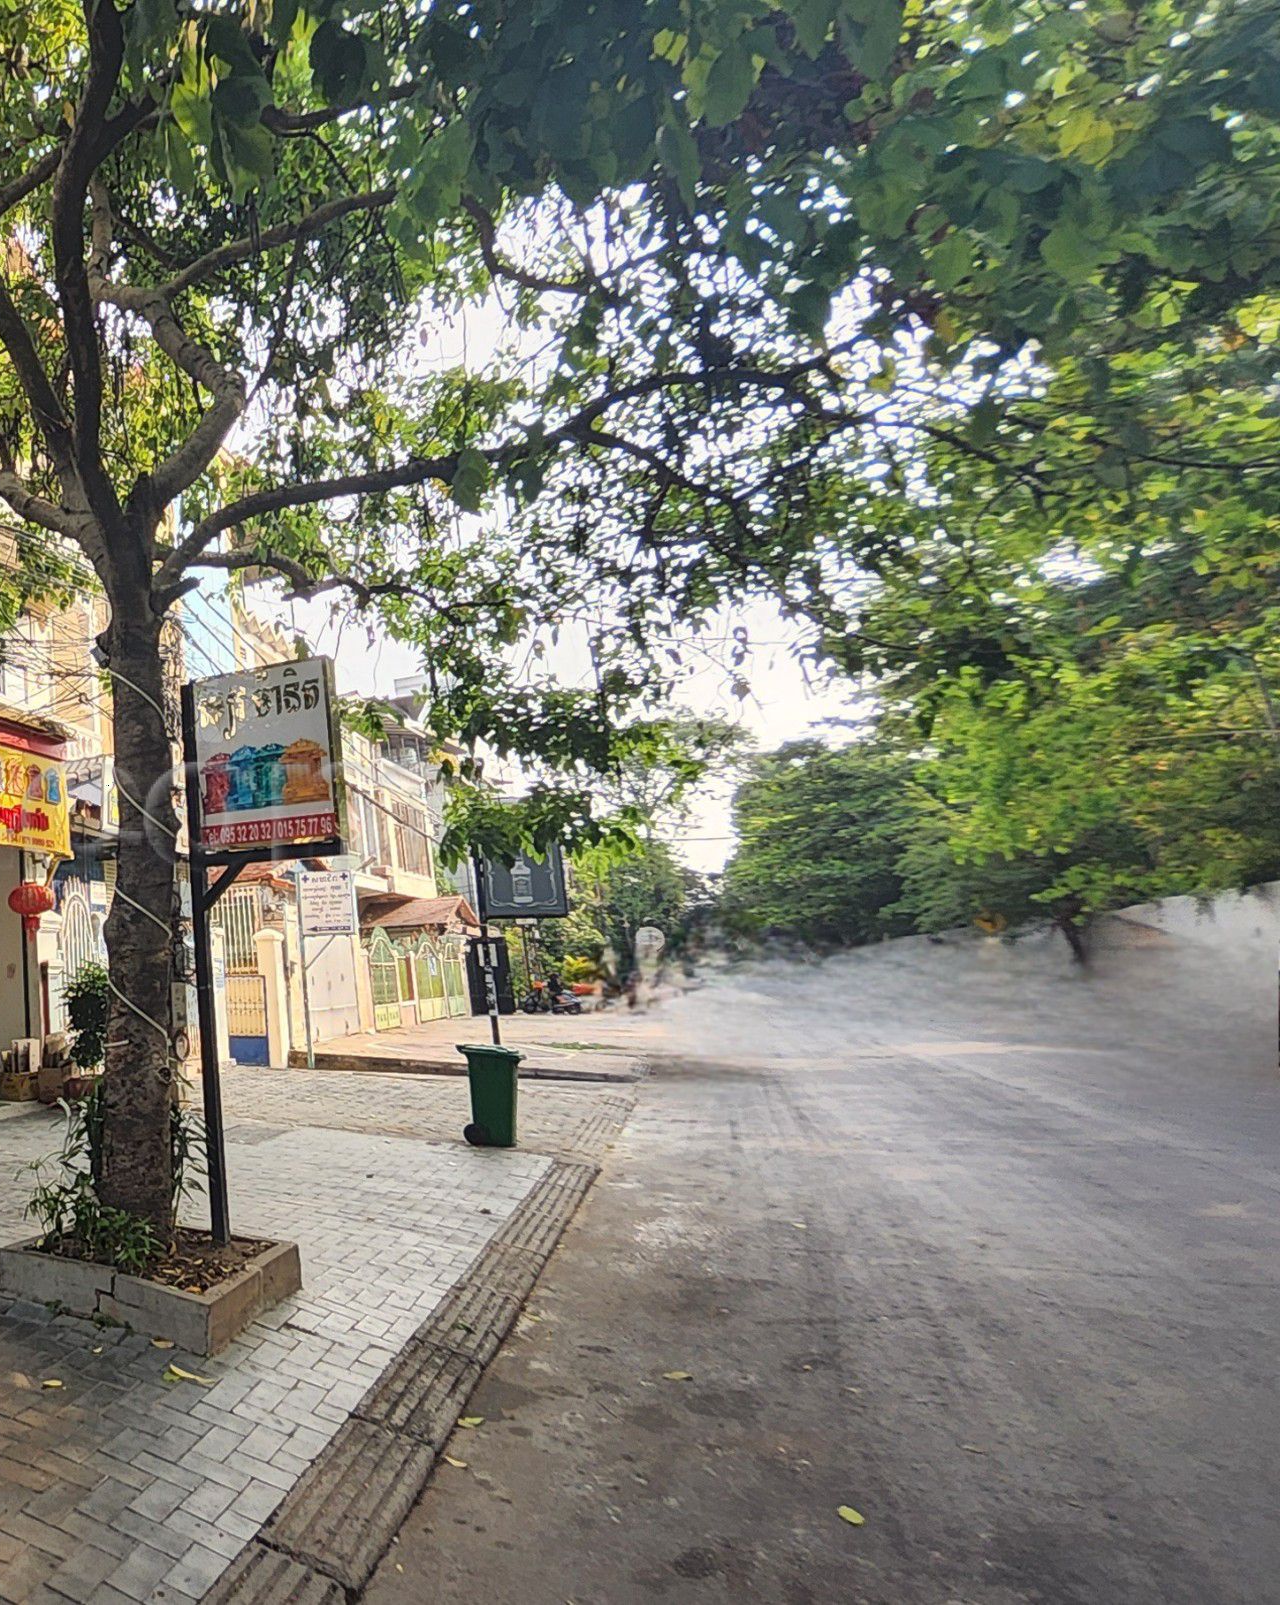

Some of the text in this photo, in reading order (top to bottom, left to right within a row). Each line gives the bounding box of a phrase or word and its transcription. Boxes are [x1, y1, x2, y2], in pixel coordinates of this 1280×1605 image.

[220, 826, 236, 844] 095
[236, 825, 248, 842] 32
[248, 823, 259, 841] 20
[260, 822, 272, 840] 32
[278, 819, 294, 838] 015
[295, 818, 306, 836] 75
[307, 817, 319, 835] 77
[321, 816, 333, 834] 96
